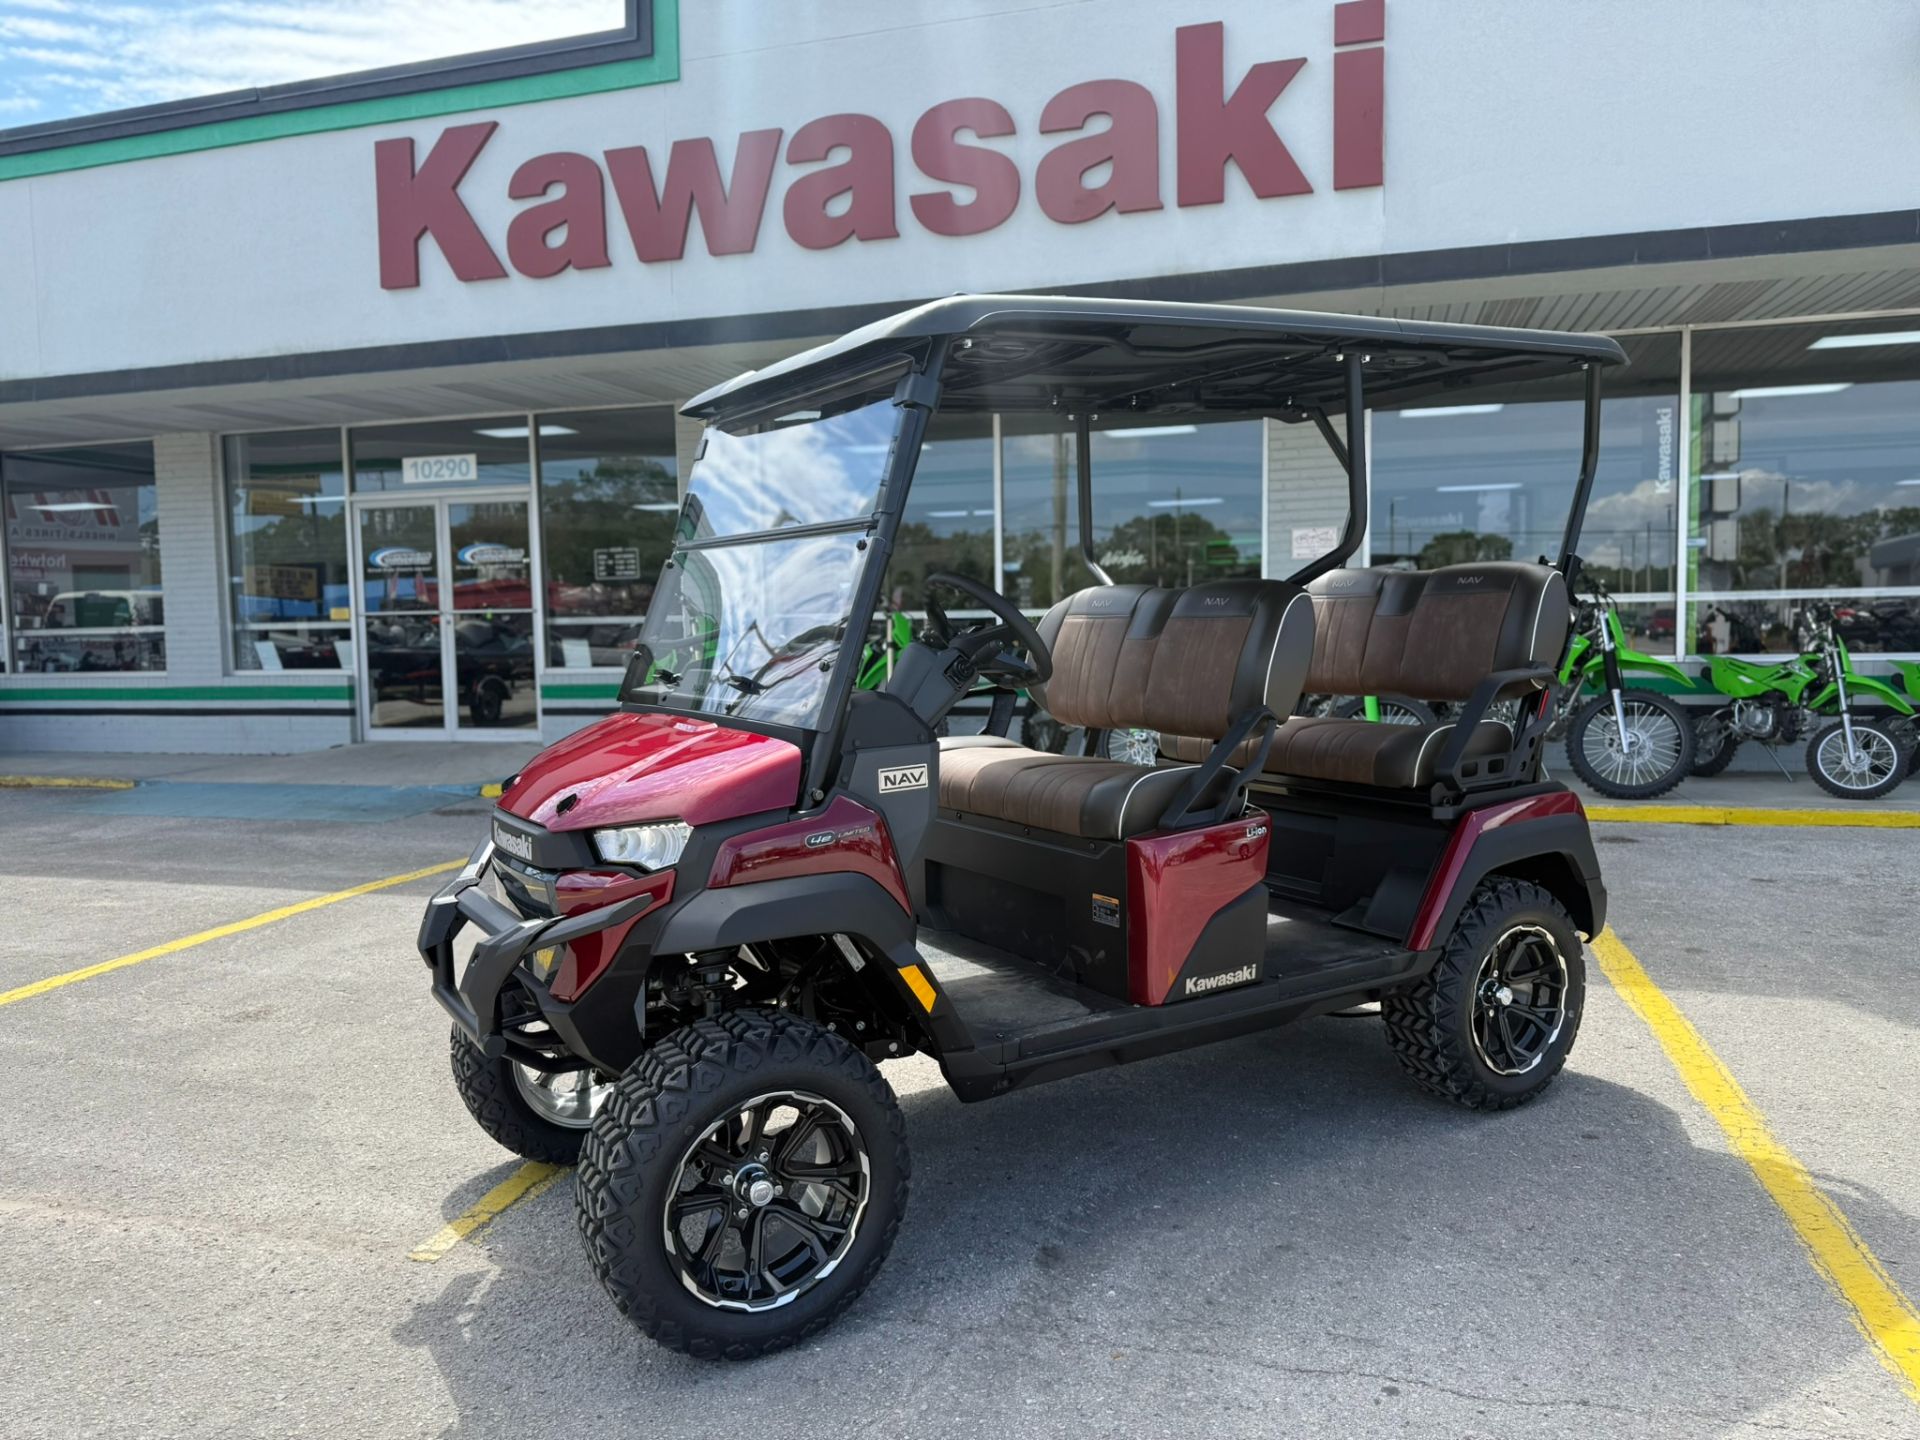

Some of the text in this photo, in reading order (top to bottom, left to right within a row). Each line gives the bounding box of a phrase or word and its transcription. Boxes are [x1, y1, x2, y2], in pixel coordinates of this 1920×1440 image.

[374, 0, 1385, 290] Kawasaki
[1655, 407, 1672, 494] Kawasaki
[410, 458, 470, 479] 10290
[1331, 580, 1354, 588] NAV
[1457, 576, 1484, 584] NAV
[1204, 597, 1230, 606] NAV
[883, 771, 924, 787] NAV
[493, 819, 532, 861] Kawasaki
[1185, 963, 1257, 995] Kawasaki
